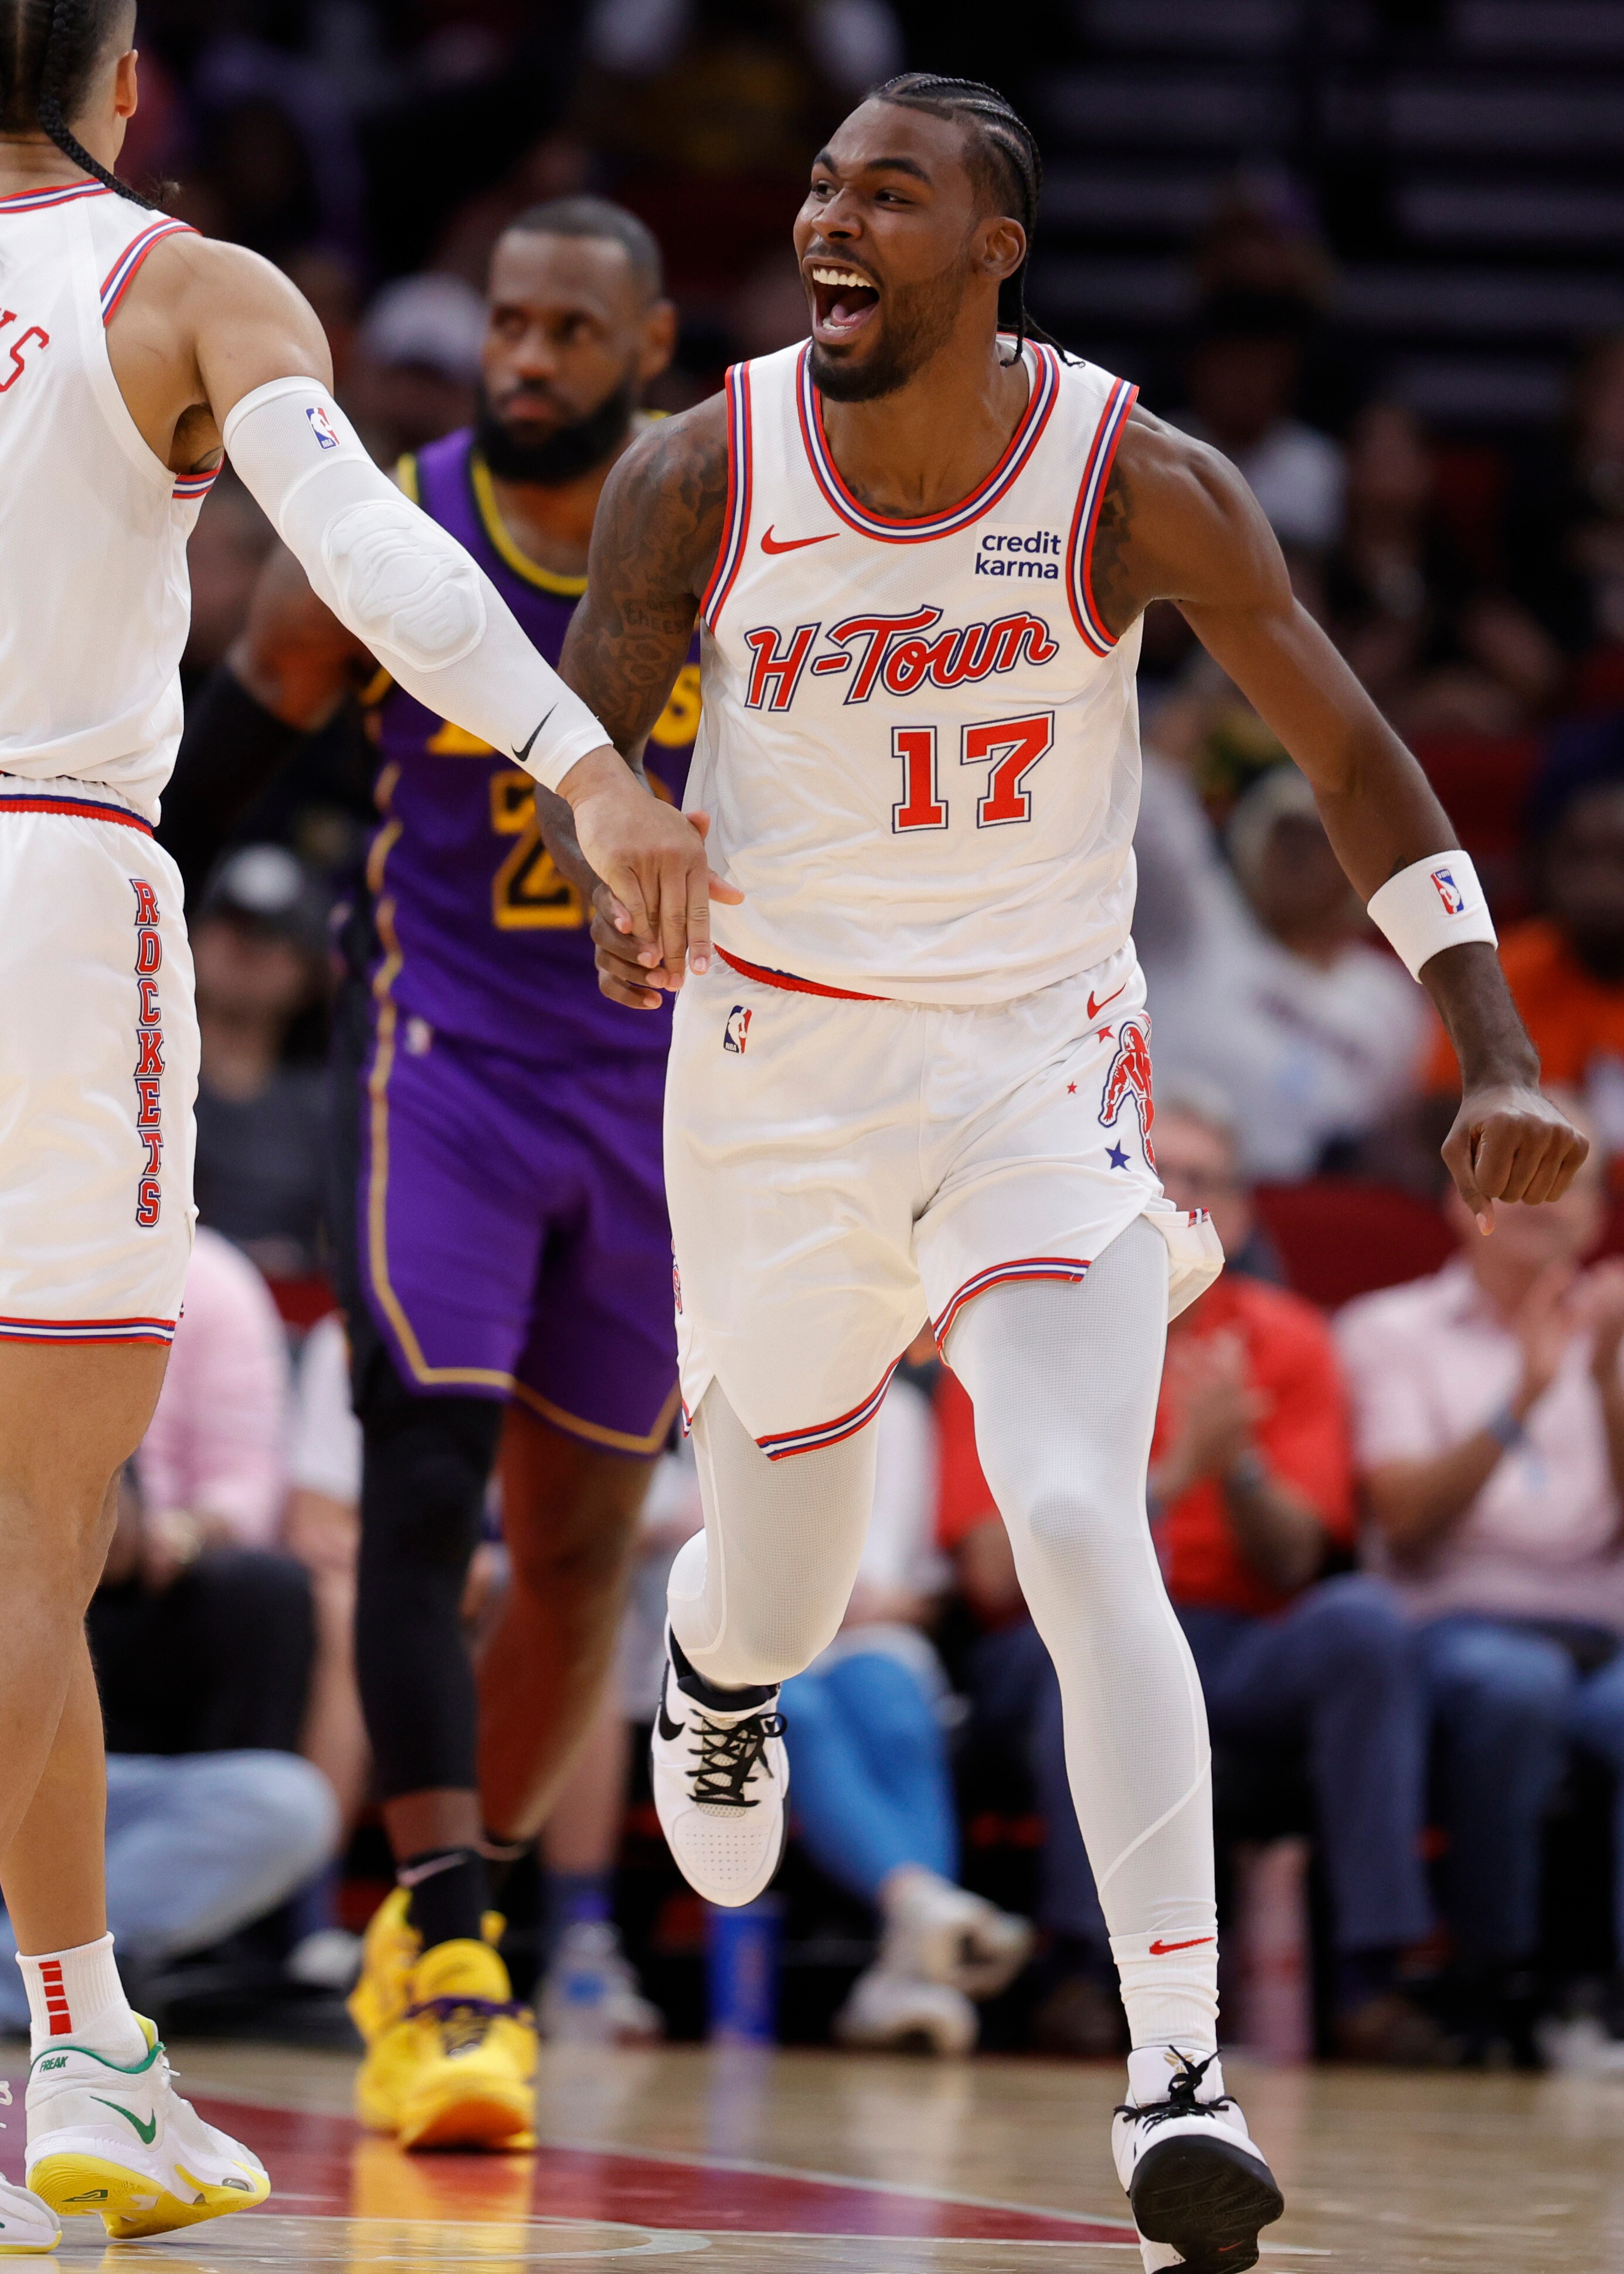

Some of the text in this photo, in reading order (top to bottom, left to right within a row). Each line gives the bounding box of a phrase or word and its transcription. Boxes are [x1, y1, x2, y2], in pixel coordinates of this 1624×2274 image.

[982, 531, 1062, 555] credit
[975, 552, 1059, 580] karma
[744, 604, 1059, 712] H-Town
[891, 710, 1055, 834] 17
[129, 878, 165, 1228] ROCKETS
[725, 1042, 737, 1051] NBA
[39, 2056, 69, 2073] FREAK
